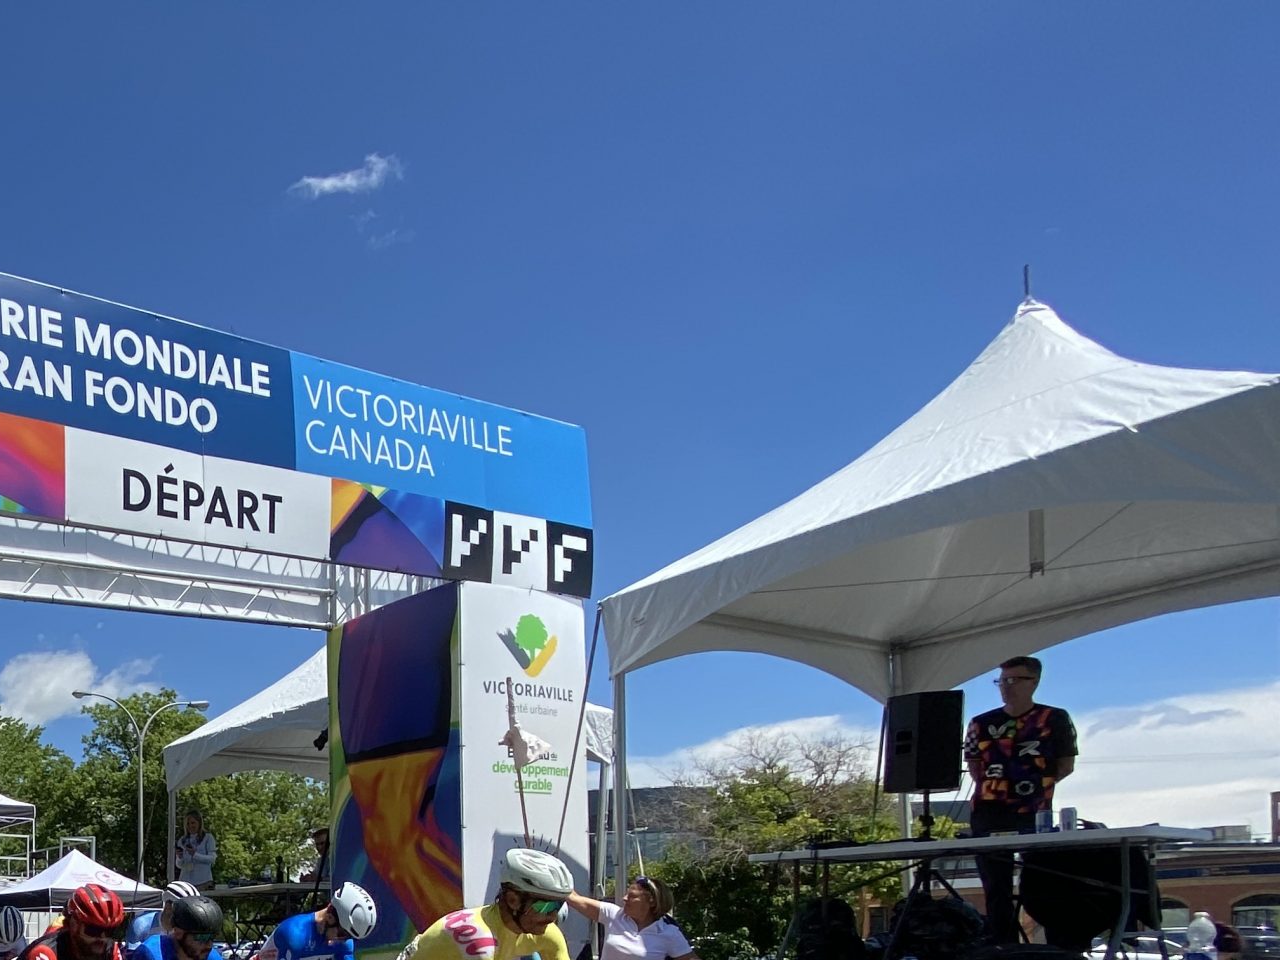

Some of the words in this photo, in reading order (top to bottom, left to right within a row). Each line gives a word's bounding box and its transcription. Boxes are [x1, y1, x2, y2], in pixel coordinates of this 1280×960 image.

[74, 316, 271, 397] MONDIALE
[85, 369, 218, 433] FONDO
[303, 375, 513, 456] VICTORIAVILLE
[305, 420, 435, 477] CANADA
[122, 463, 283, 534] DÉPART
[483, 680, 573, 702] VICORIAVILLE
